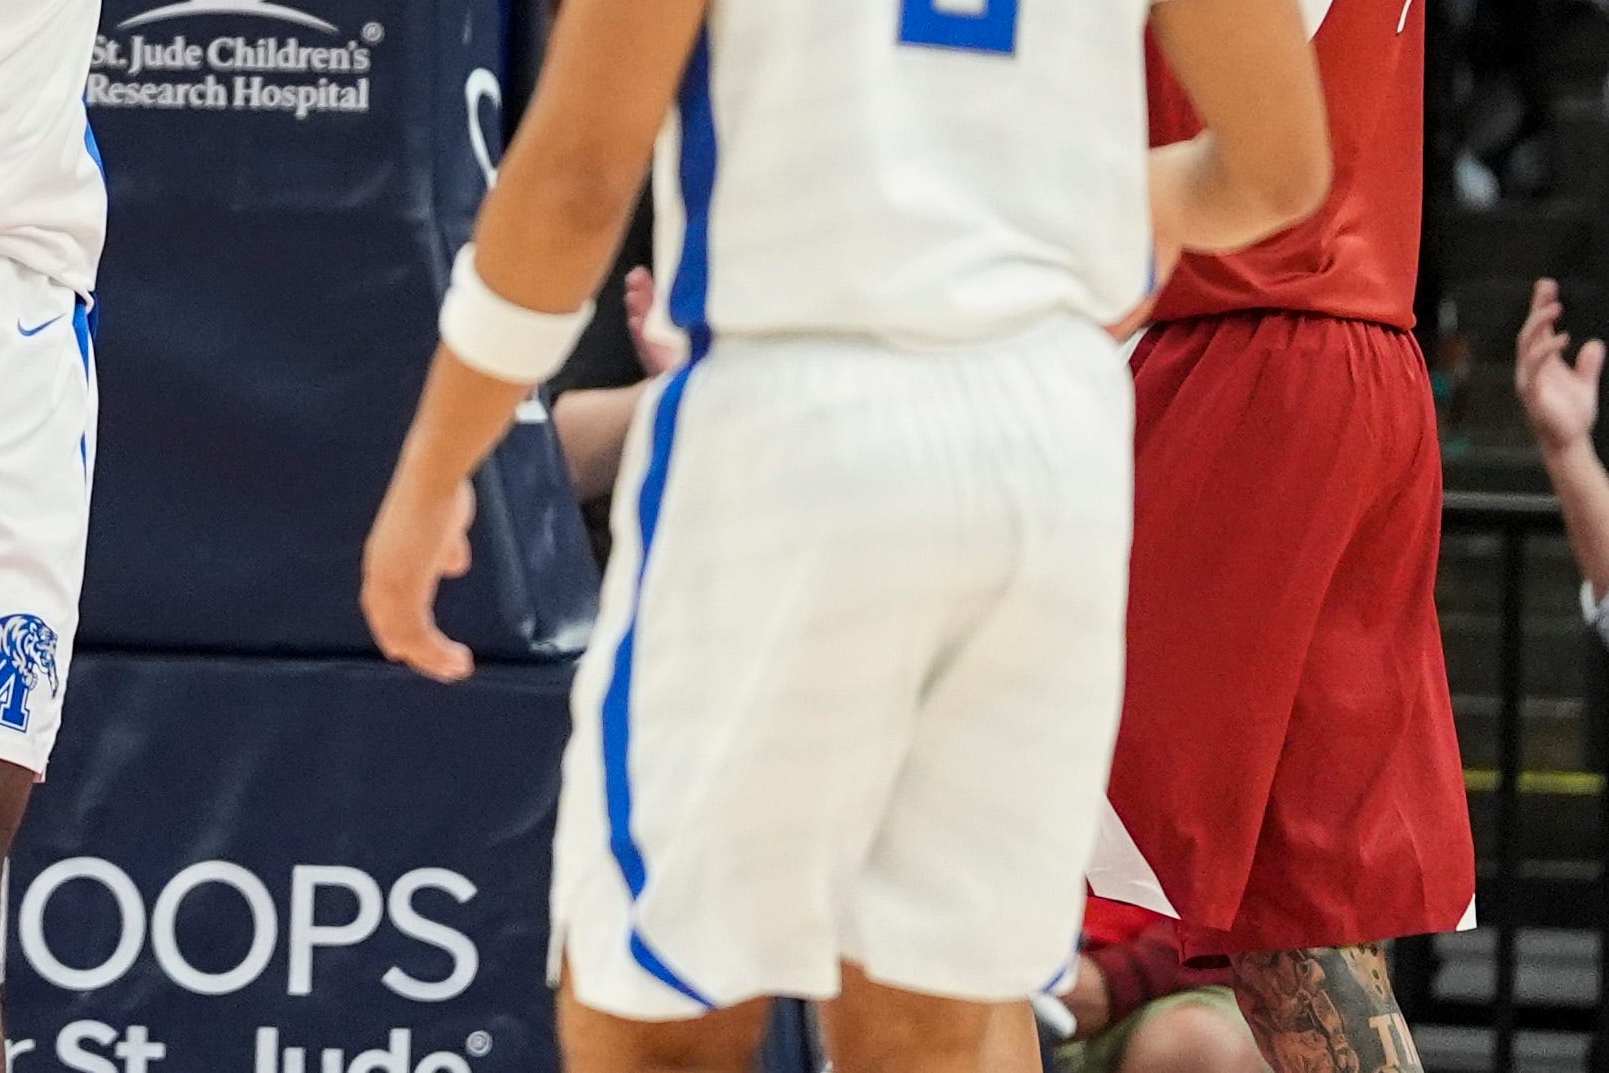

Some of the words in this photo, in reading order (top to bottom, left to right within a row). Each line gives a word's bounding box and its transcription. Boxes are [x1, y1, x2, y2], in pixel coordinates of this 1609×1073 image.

[91, 34, 127, 68] St.
[128, 35, 204, 74] Jude
[89, 73, 228, 109] Research
[233, 76, 370, 120] Hospital
